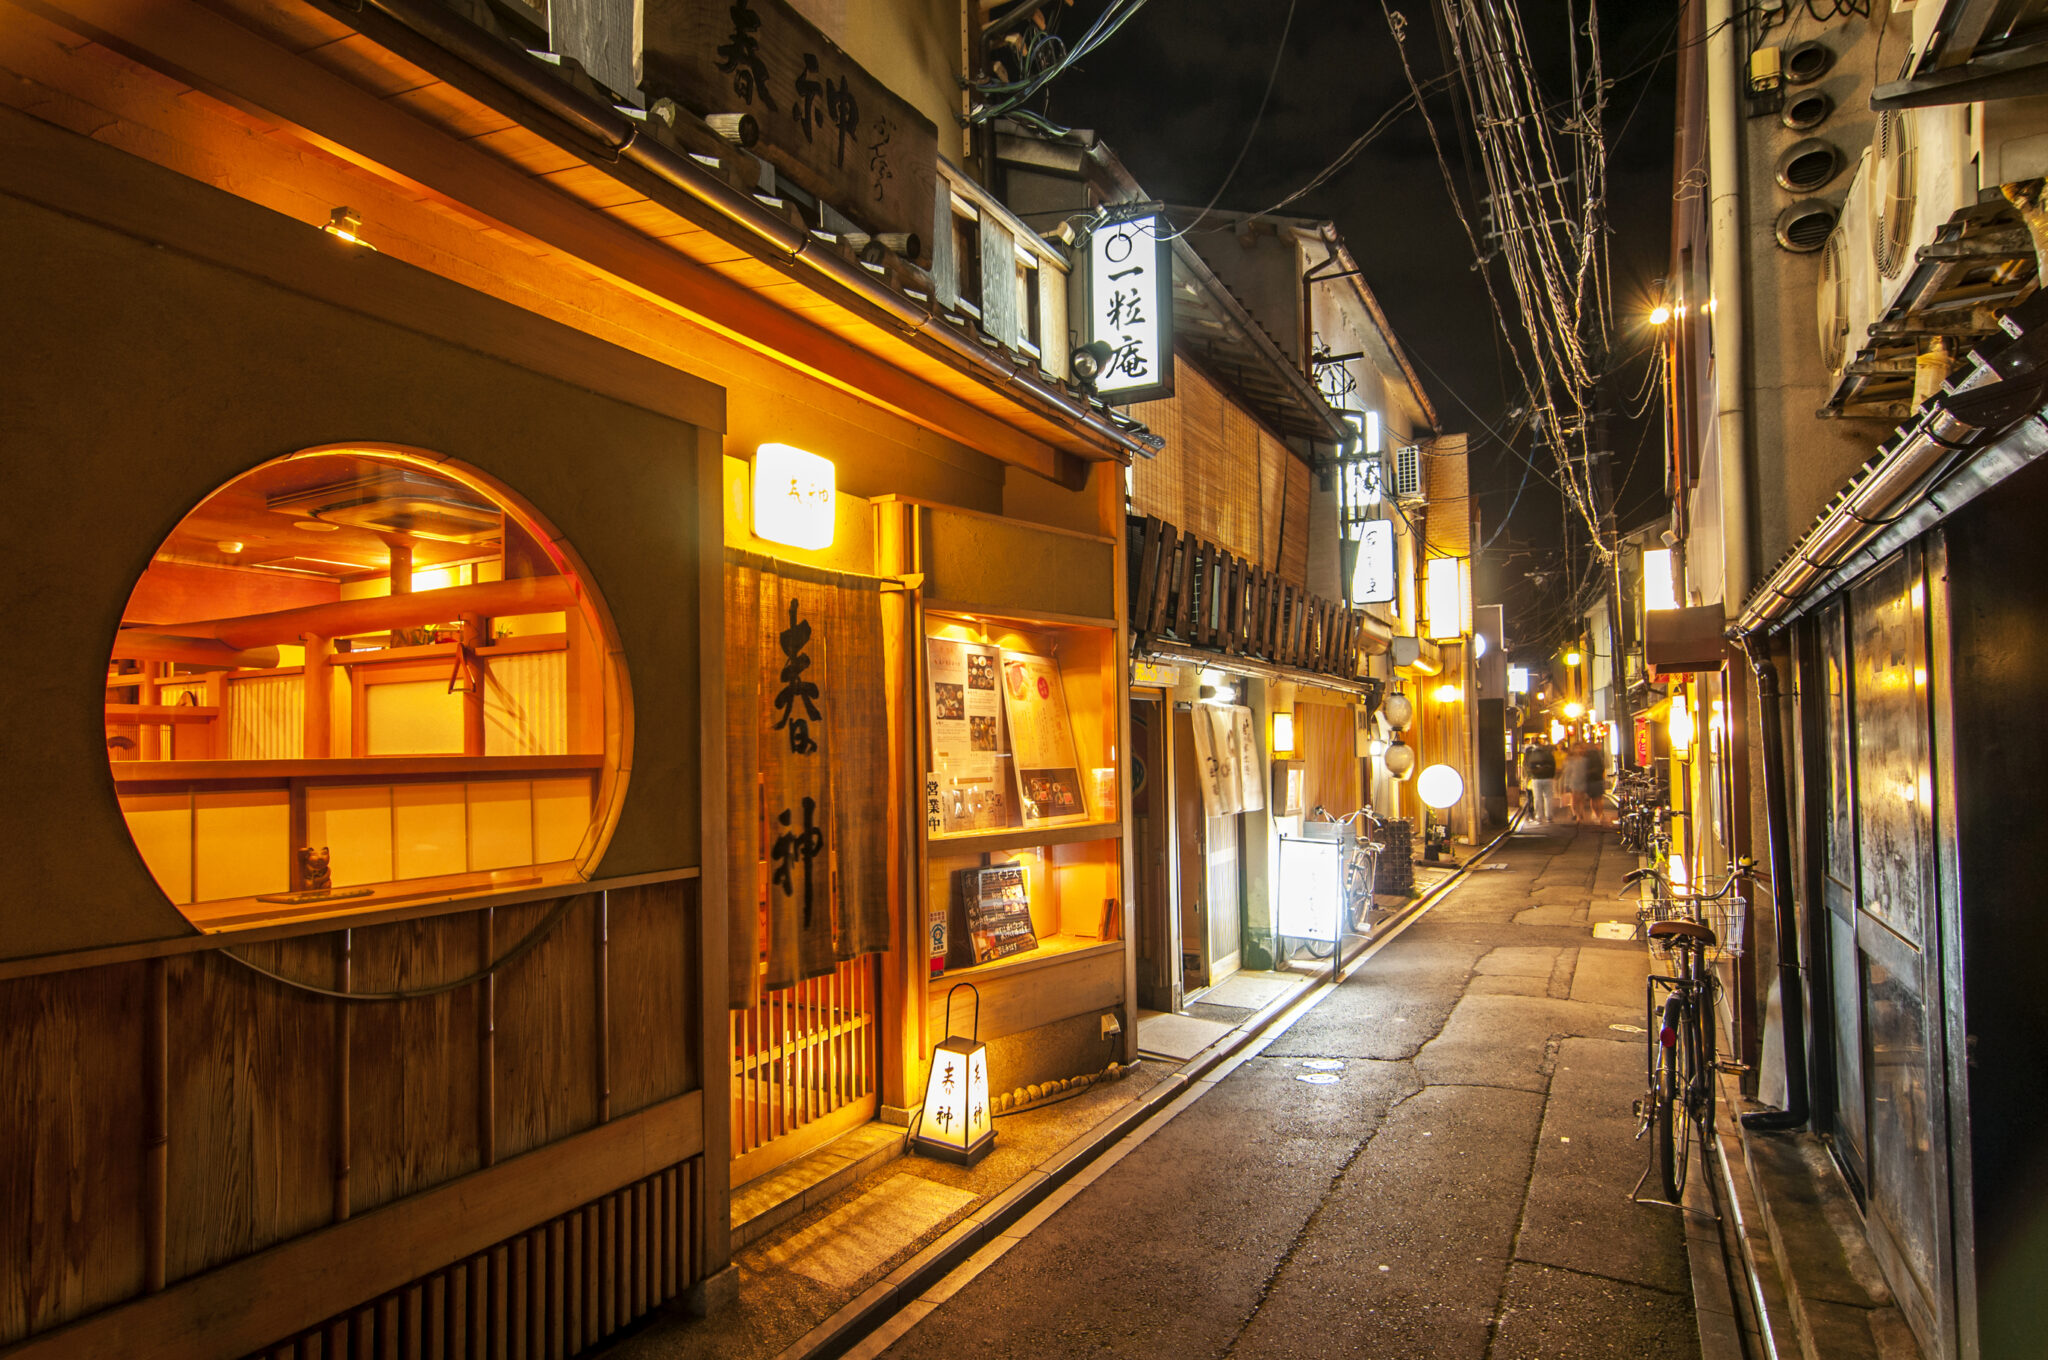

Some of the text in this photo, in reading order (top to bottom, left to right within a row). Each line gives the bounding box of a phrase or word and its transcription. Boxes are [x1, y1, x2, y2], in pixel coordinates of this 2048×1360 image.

[713, 0, 860, 169] 春神
[772, 597, 824, 932] 春神
[927, 780, 941, 833] 営業中
